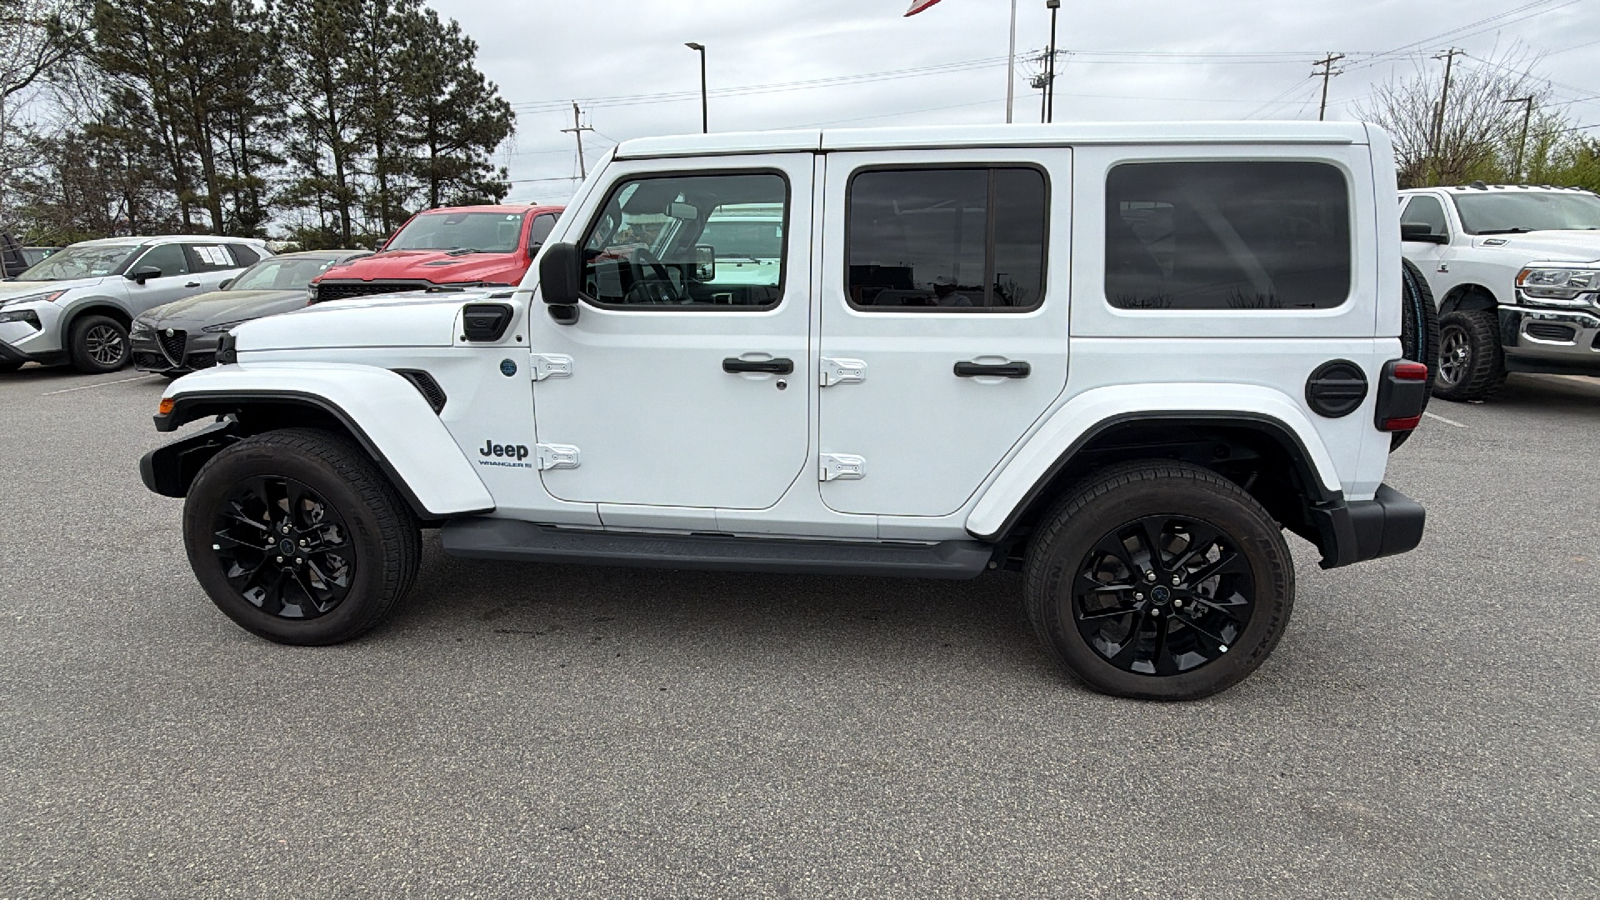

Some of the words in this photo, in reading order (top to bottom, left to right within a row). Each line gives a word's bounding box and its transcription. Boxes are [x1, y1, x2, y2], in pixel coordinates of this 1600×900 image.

[479, 440, 528, 461] Jeep
[478, 460, 523, 468] WRANGLER
[1046, 565, 1062, 640] NEXEN
